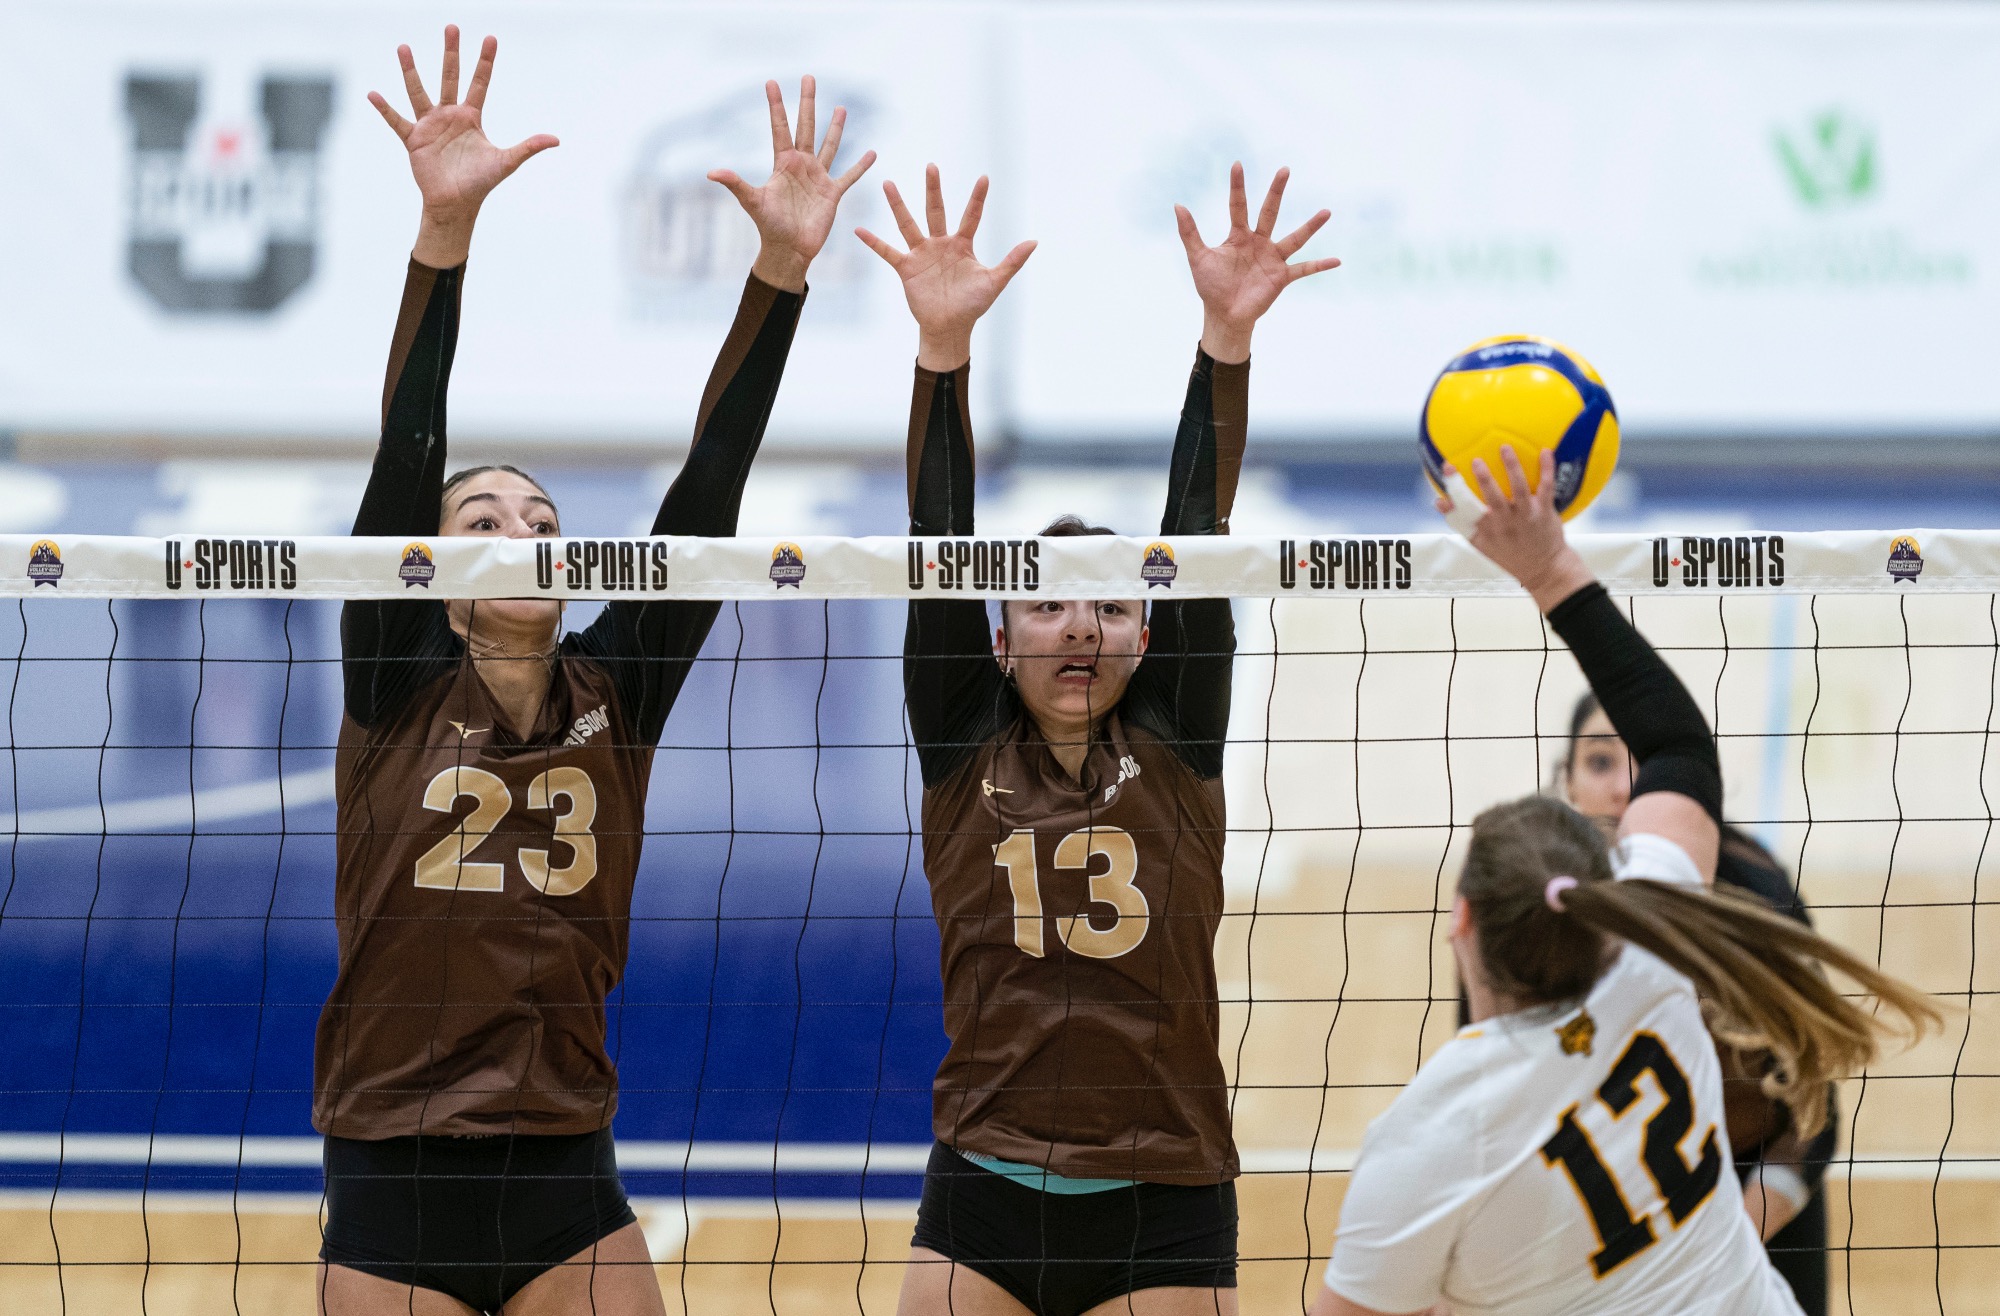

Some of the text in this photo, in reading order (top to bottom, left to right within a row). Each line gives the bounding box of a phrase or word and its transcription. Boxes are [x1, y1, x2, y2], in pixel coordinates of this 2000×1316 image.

[165, 539, 297, 590] U SPORTS
[536, 541, 668, 591] U SPORTS
[908, 540, 1039, 591] U SPORTS
[1280, 539, 1412, 590] U SPORTS
[1653, 536, 1785, 588] U SPORTS
[414, 765, 598, 896] 23
[992, 825, 1150, 959] 13
[1537, 1028, 1722, 1281] 12
